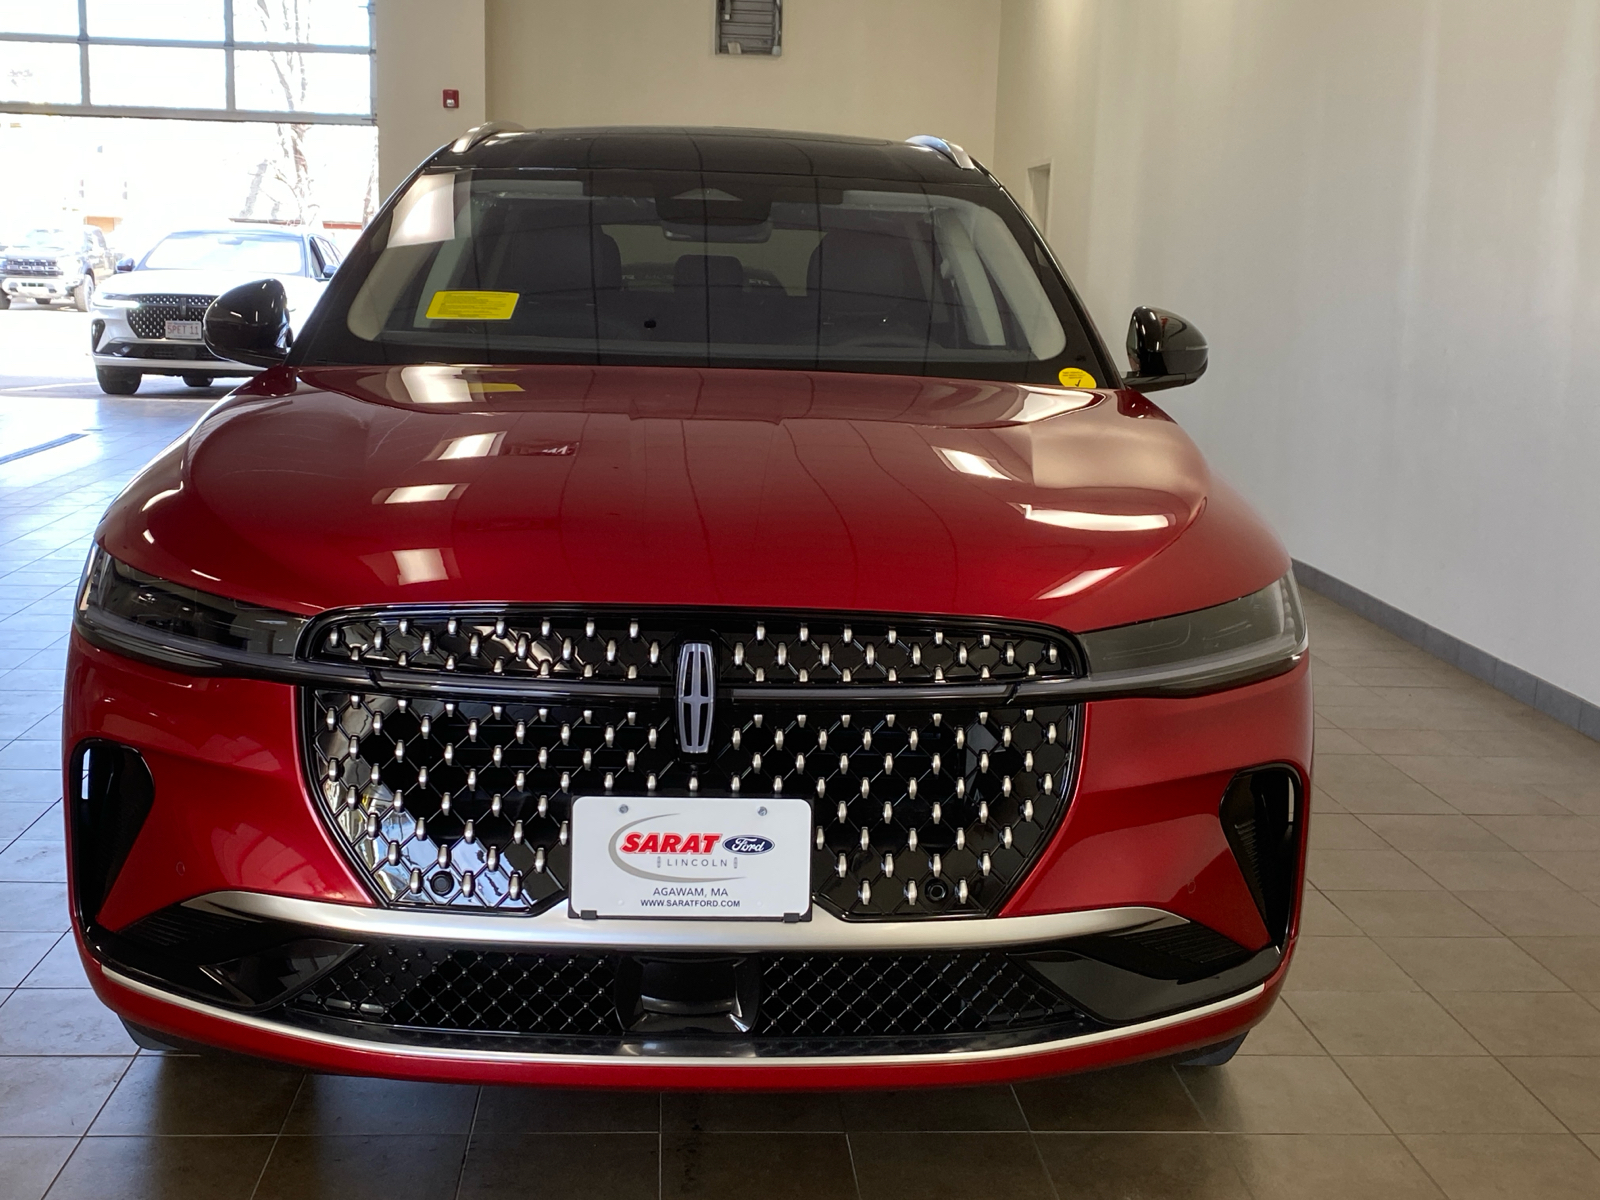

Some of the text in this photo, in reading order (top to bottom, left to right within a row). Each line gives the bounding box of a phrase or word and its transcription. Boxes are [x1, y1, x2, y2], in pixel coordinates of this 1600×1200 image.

[620, 831, 766, 855] SARAT Ford
[667, 858, 728, 867] LINCOLN
[652, 887, 729, 898] AGAWAM, MA
[640, 899, 741, 908] WWW.SARATFORD.COM
